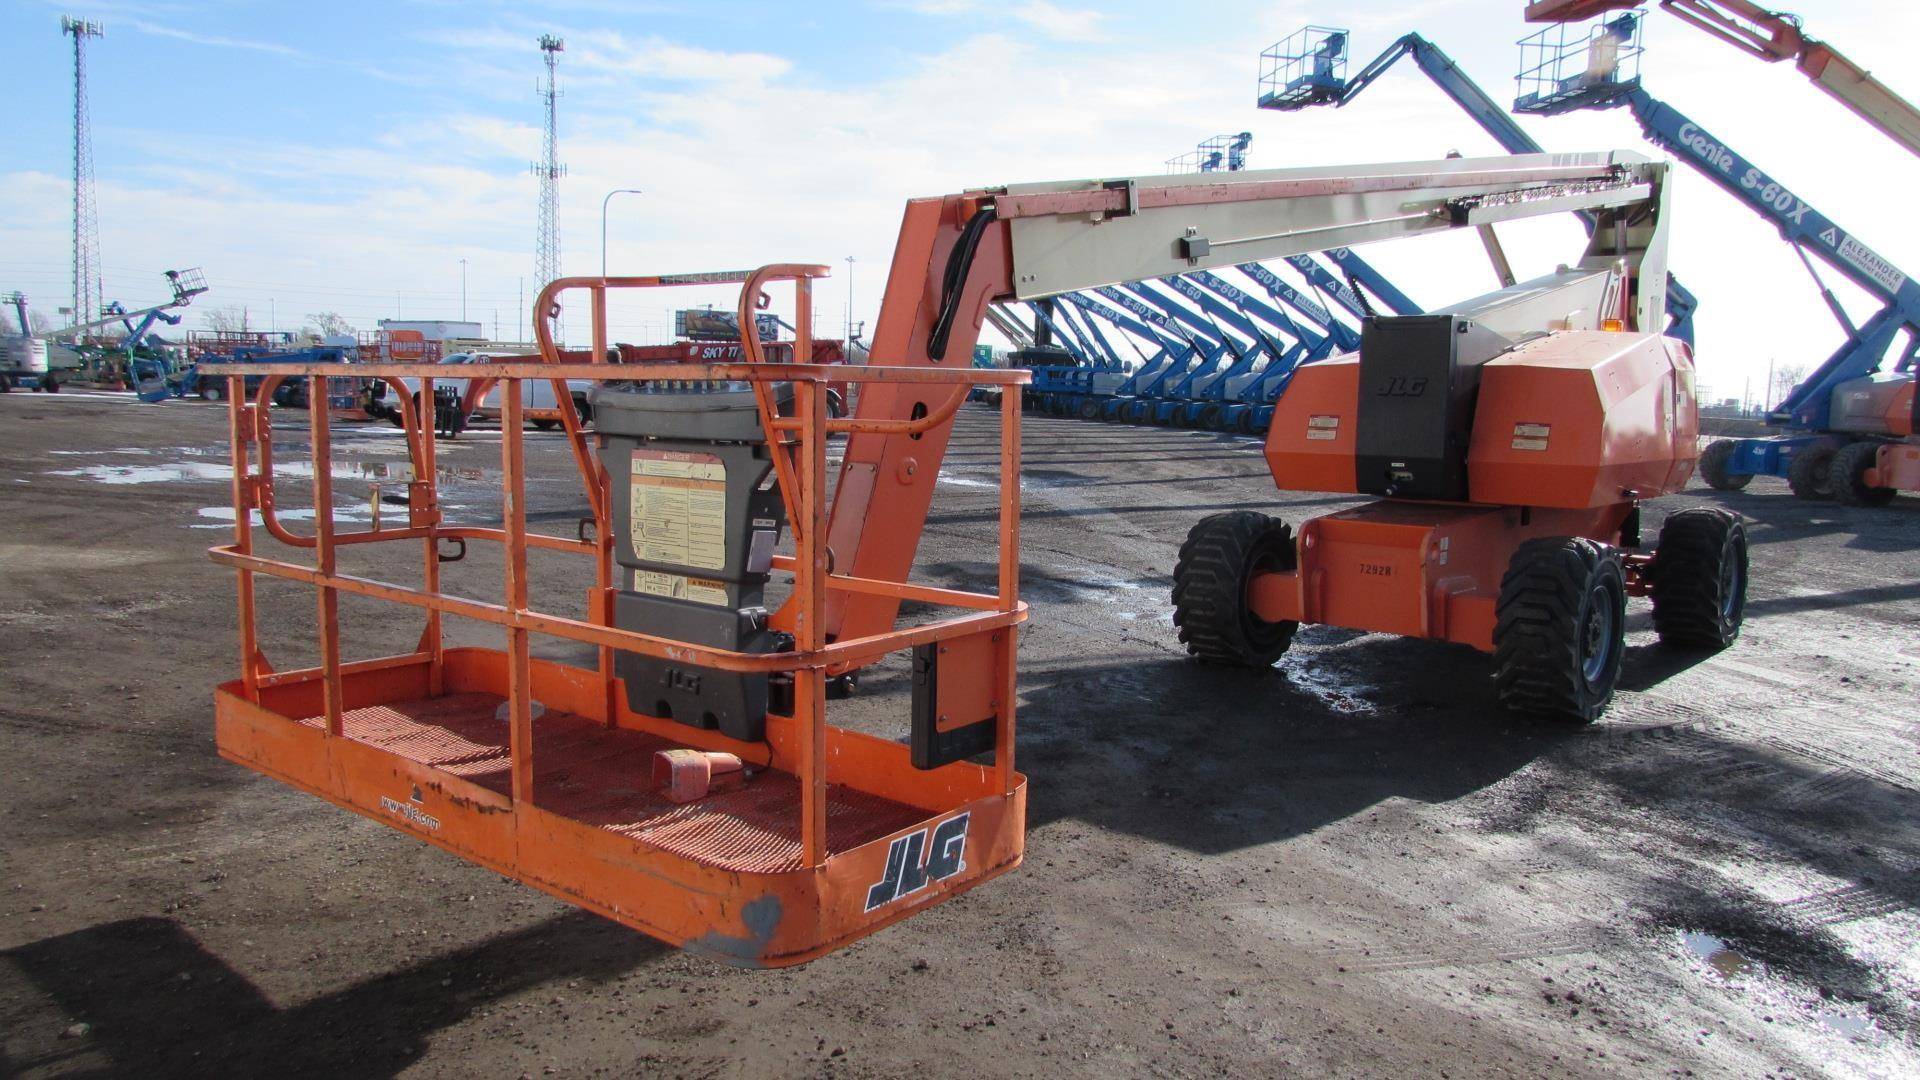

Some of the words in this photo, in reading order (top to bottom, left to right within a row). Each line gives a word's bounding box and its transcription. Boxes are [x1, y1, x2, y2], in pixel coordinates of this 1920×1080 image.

[1678, 121, 1732, 173] Genie
[1740, 168, 1811, 225] S-60X
[1845, 240, 1902, 283] ALEXANDER
[1174, 278, 1202, 301] S-60
[1208, 278, 1247, 304] S-60X
[1244, 263, 1284, 293] S-60X
[1091, 302, 1121, 322] S-60X
[1122, 296, 1155, 319] S-60X
[702, 347, 726, 359] SKY
[1377, 376, 1429, 397] JLG
[659, 665, 702, 695] JLG
[864, 811, 970, 914] JLG
